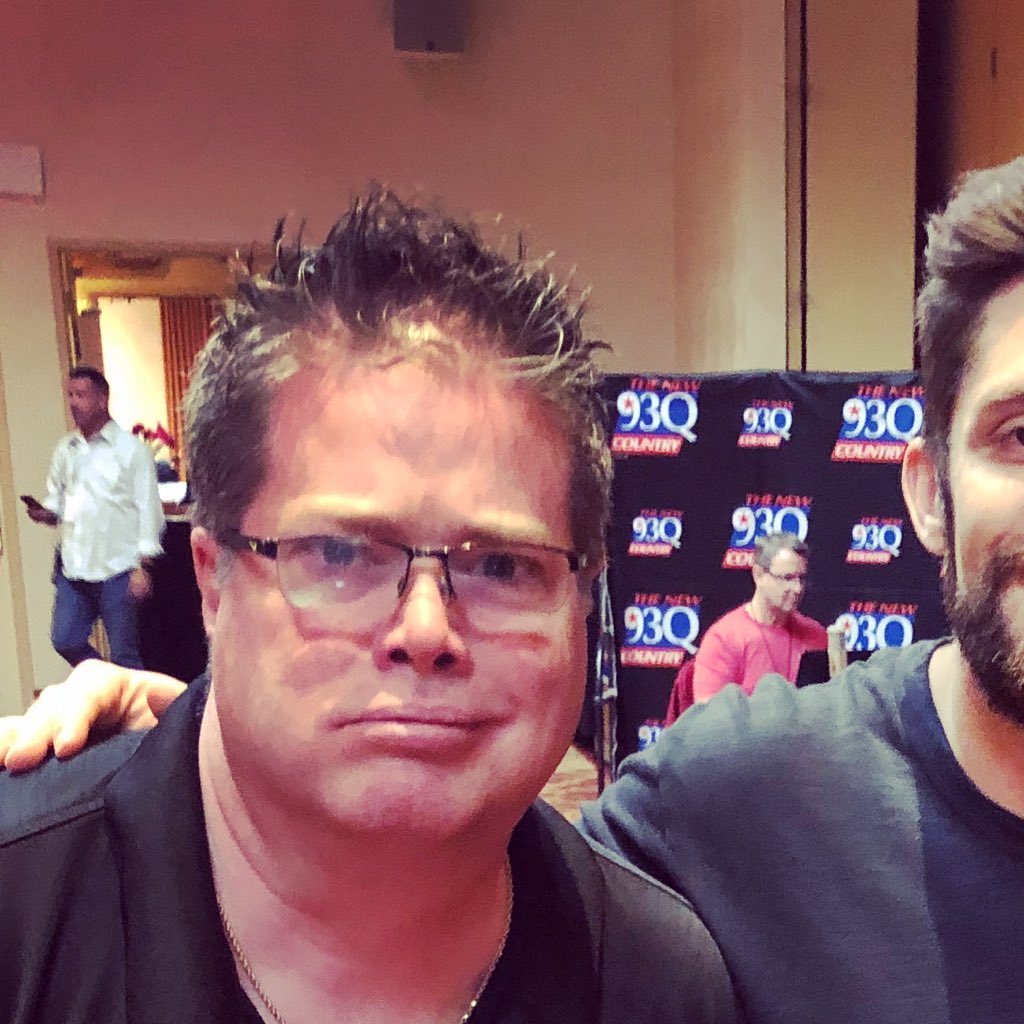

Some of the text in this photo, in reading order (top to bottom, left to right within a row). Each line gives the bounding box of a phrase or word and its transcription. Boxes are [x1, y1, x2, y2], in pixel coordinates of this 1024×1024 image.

[616, 390, 699, 443] 93Q
[742, 407, 793, 441] 93Q
[842, 397, 923, 443] 93Q
[611, 436, 682, 453] COUNTRY
[834, 443, 905, 460] COUNTRY
[632, 516, 682, 549] 93Q
[852, 523, 902, 558] 93Q
[624, 606, 700, 655] 93Q
